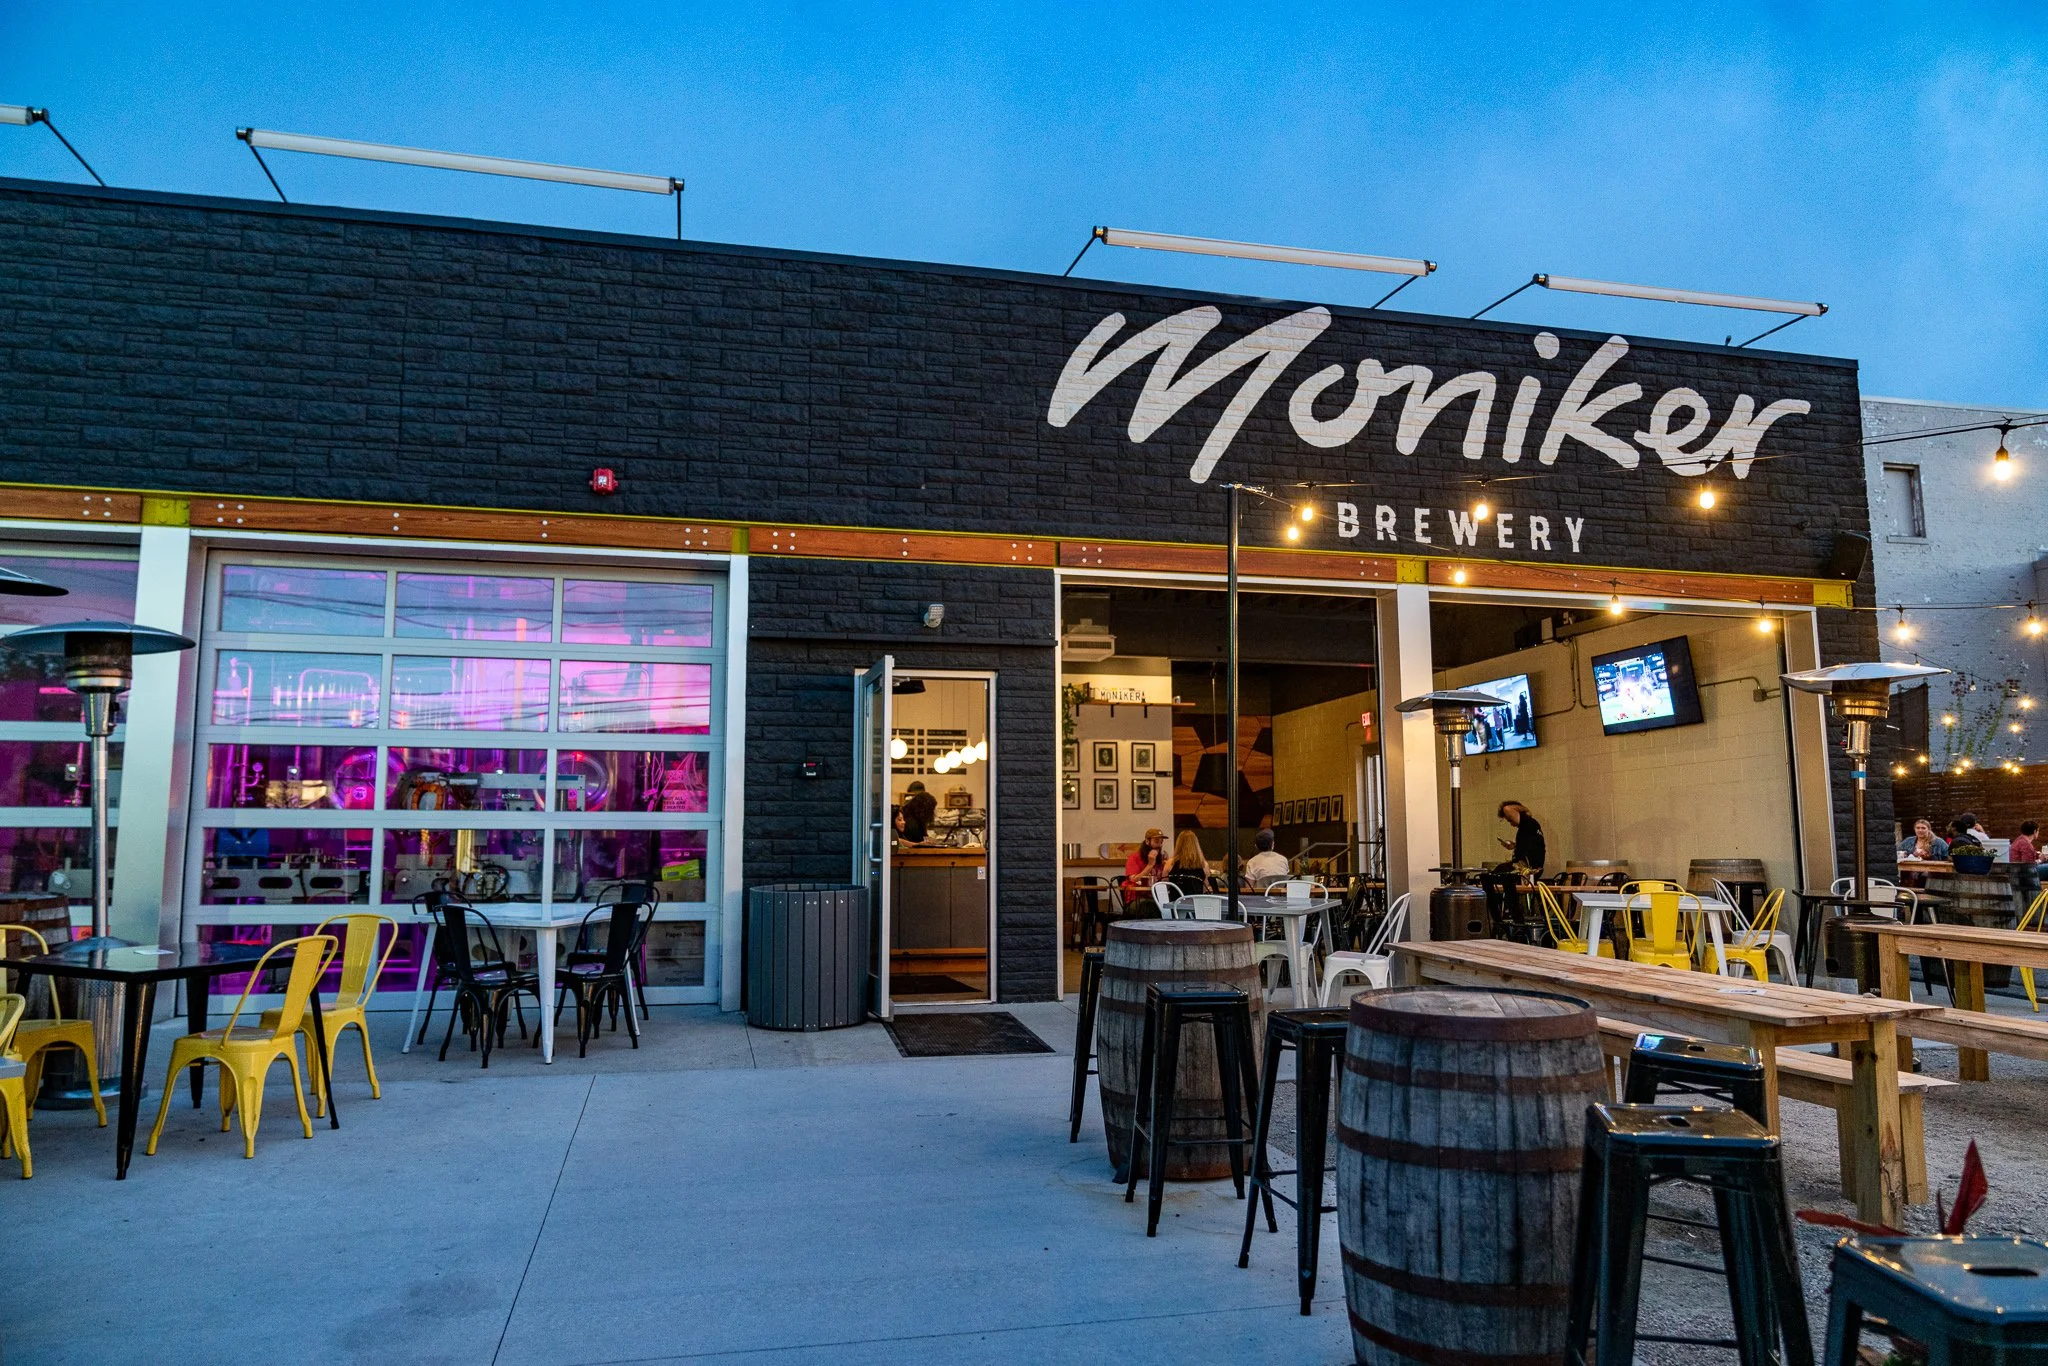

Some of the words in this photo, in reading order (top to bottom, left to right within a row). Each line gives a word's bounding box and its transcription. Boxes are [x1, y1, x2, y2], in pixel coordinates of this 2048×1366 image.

[1047, 305, 1812, 484] Moniker
[1336, 501, 1586, 554] BREWERY
[1100, 690, 1141, 701] MONIKER
